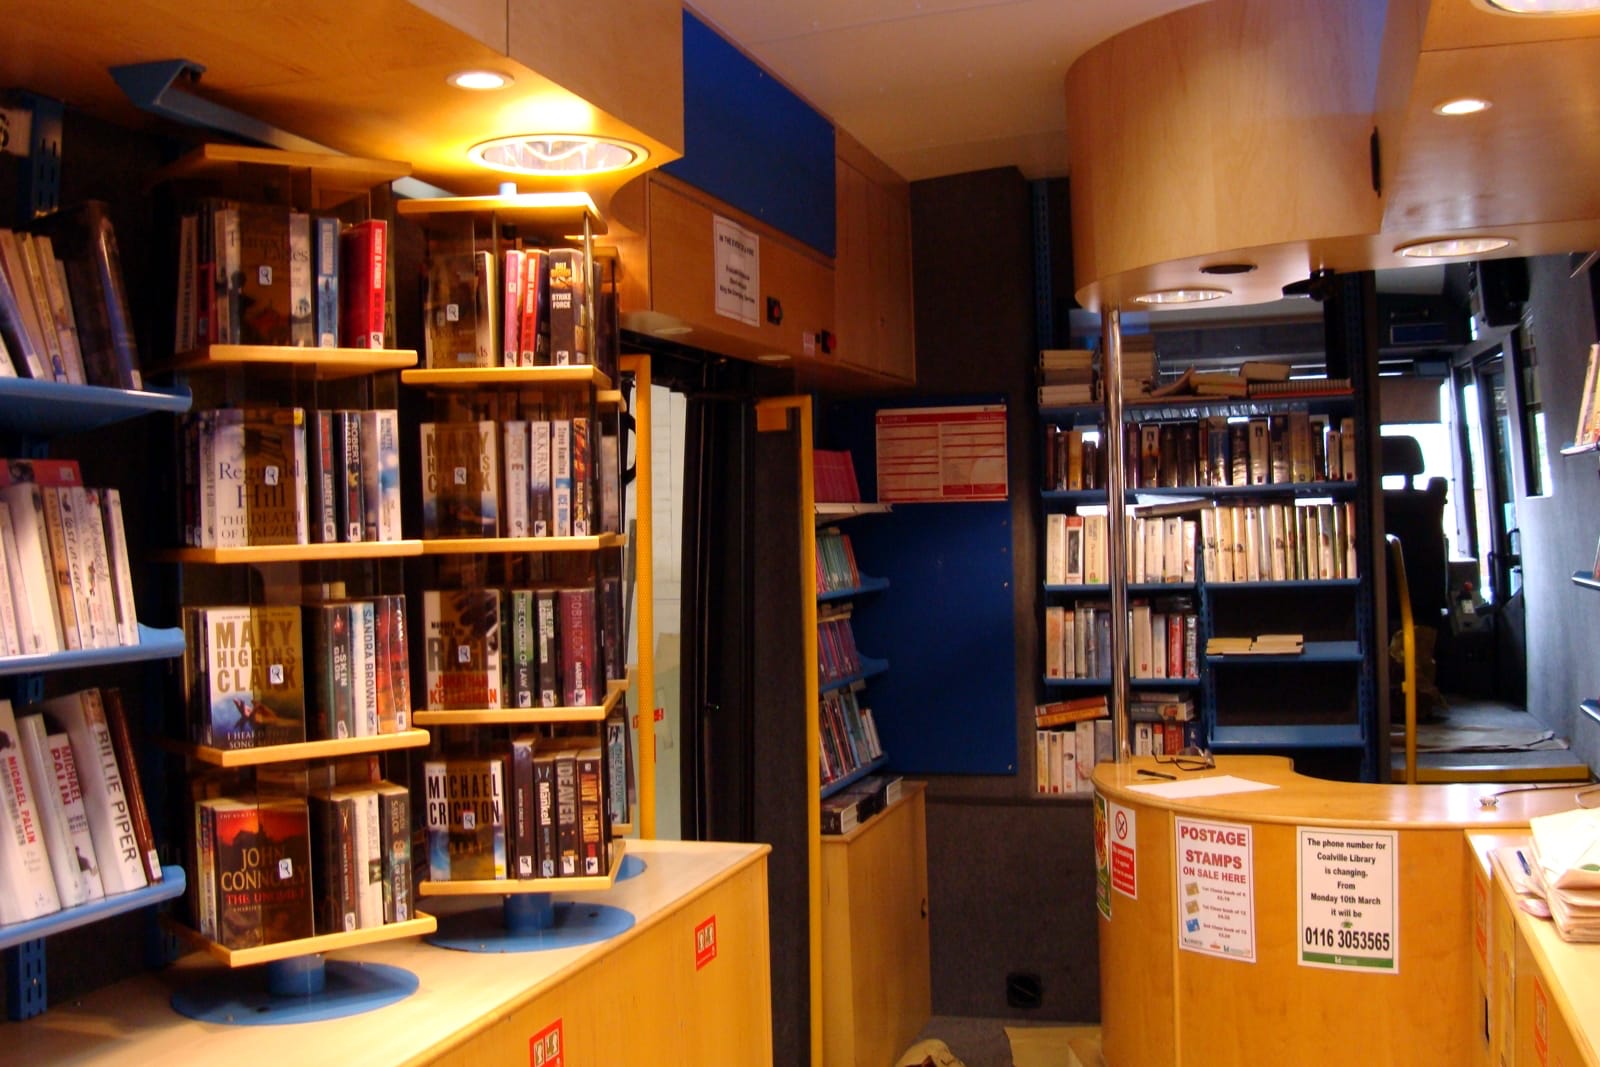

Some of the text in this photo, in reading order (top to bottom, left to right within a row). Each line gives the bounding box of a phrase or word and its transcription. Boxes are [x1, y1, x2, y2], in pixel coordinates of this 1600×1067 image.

[552, 292, 572, 300] STRIKE
[553, 301, 570, 310] FORCE
[352, 422, 360, 464] ROBERT
[238, 482, 286, 508] Hill
[572, 594, 582, 629] ROBIN
[216, 620, 293, 649] MARY
[217, 648, 296, 668] HIGGINS
[340, 654, 348, 687] SKIN
[364, 608, 375, 709] SANDRA BROWN
[520, 667, 528, 688] LAW
[50, 748, 73, 806] PALIN
[61, 744, 81, 802] MICHAEL
[428, 774, 500, 799] MICHAEL
[557, 764, 576, 825] DEAVER
[8, 755, 37, 844] MICHAEL PALIN
[540, 782, 552, 826] Mankell
[392, 800, 400, 834] SAYLOR
[428, 800, 500, 825] CRICHTON
[113, 802, 138, 862] PIPER
[1180, 826, 1246, 847] POSTAGE
[1308, 838, 1386, 850] The phone number for
[241, 847, 285, 872] JOHN
[1186, 849, 1242, 870] STAMPS
[1317, 852, 1376, 865] Coalville Library
[1183, 866, 1246, 884] ON SALE HERE
[1324, 867, 1368, 879] is changing.
[1337, 881, 1356, 890] From
[1310, 892, 1381, 905] Monday 10th March
[1331, 908, 1362, 918] it will be
[1305, 926, 1390, 952] 0116 3053565
